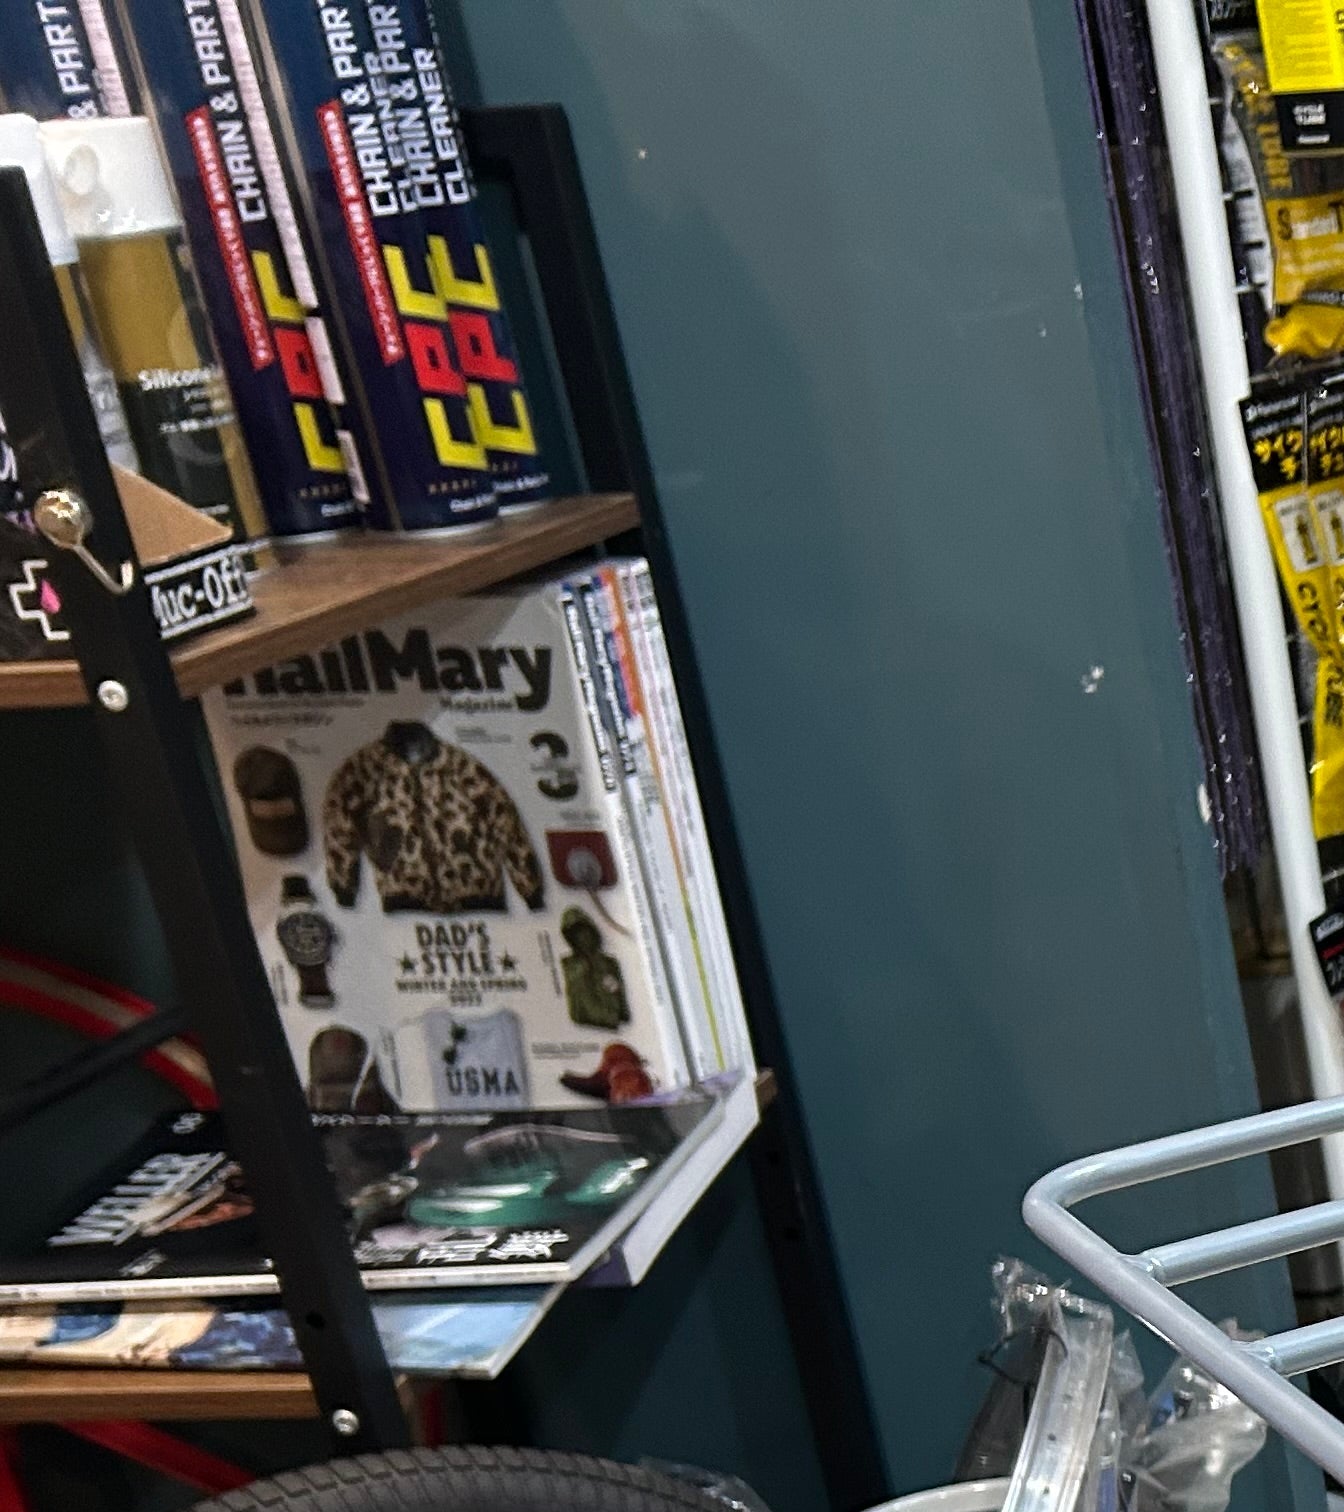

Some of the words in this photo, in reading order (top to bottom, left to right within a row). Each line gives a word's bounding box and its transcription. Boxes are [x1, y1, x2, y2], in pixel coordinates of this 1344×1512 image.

[367, 0, 412, 74] PAR
[208, 91, 239, 114] &
[341, 82, 371, 106] &
[390, 78, 418, 101] &
[412, 48, 470, 206] CLEANER
[216, 119, 268, 223] CHAIN
[347, 113, 400, 217] CHAIN
[394, 107, 445, 207] CHAIN
[415, 921, 491, 950] DAD'S
[421, 950, 494, 976] STYLE
[446, 1066, 521, 1097] USMA
